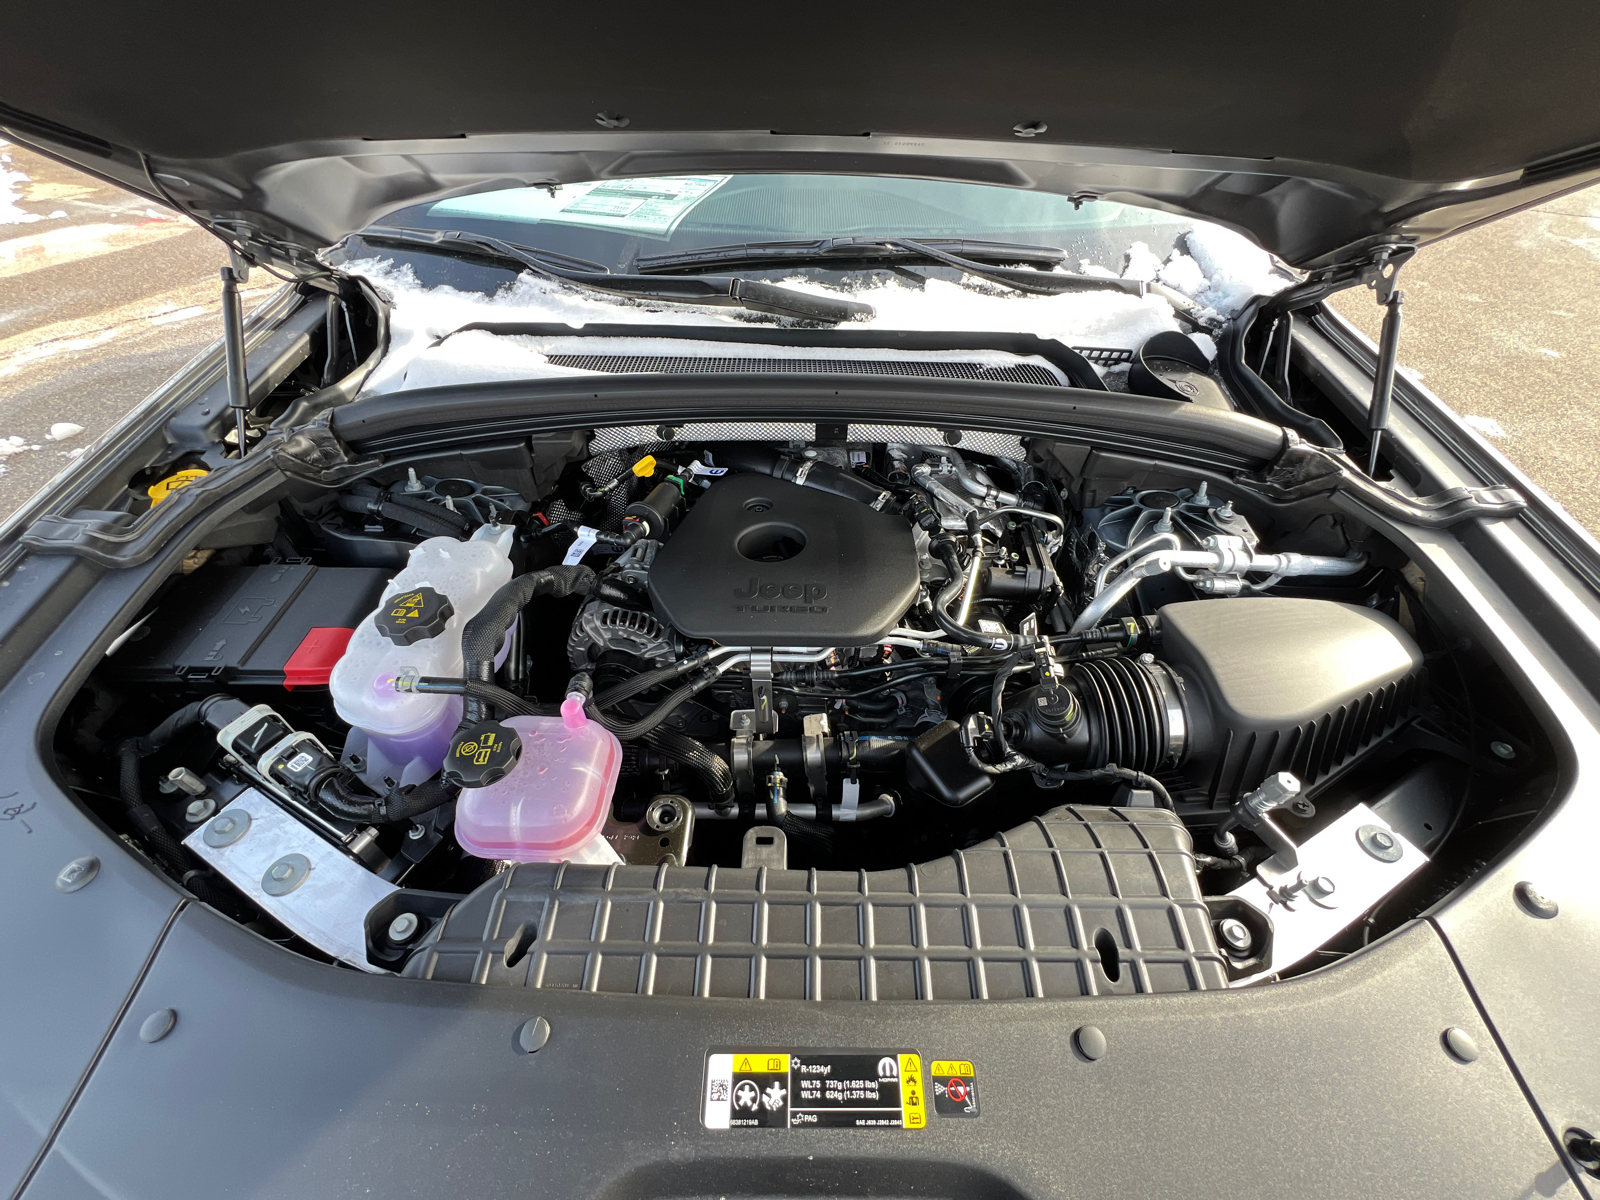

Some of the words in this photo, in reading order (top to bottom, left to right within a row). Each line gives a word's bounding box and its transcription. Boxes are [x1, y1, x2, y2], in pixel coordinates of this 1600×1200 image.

[733, 577, 828, 604] Jeep
[733, 604, 829, 613] TURBO
[800, 1064, 832, 1076] R-1234yf
[800, 1080, 821, 1089] WL75
[825, 1080, 843, 1090] 737g
[843, 1080, 864, 1090] (1.625
[864, 1080, 879, 1090] lbs)
[800, 1090, 821, 1099] WL74
[825, 1090, 843, 1100] 624g
[843, 1090, 865, 1100] (1.375
[865, 1090, 879, 1100] lbs)
[804, 1114, 818, 1122] PAG
